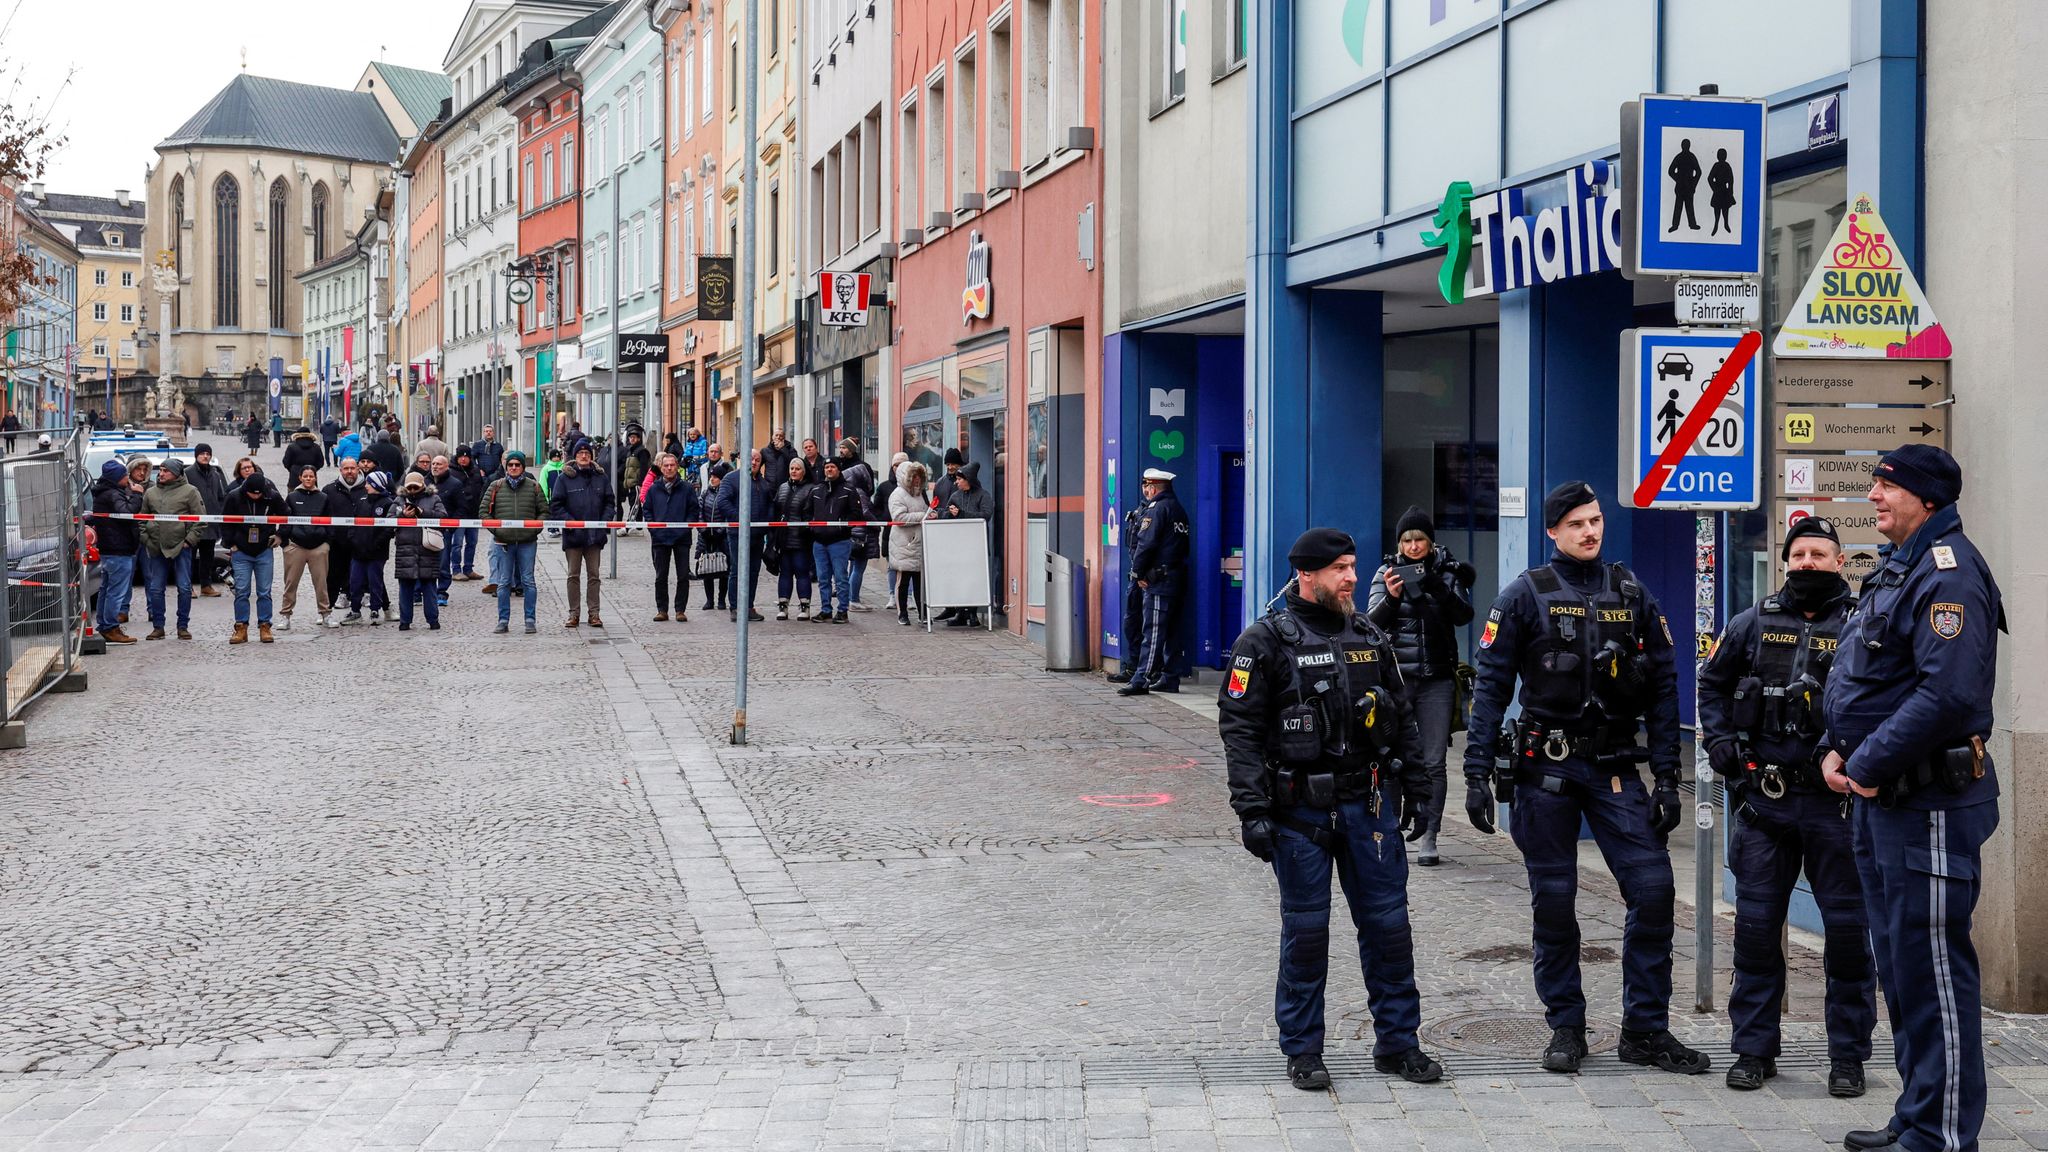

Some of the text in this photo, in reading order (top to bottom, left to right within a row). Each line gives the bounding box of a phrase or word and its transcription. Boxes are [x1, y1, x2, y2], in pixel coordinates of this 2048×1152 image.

[1816, 101, 1827, 131] 4
[1677, 281, 1758, 300] ausgenommen
[1822, 270, 1903, 298] SLOW
[829, 311, 861, 323] KFC
[1691, 302, 1745, 320] Fahrräder
[1806, 303, 1920, 326] LANGSAM
[1784, 375, 1854, 389] Lederergasse
[1705, 417, 1738, 448] 20
[1825, 422, 1896, 435] Wochenmarkt
[1818, 461, 1859, 472] KIDWAY
[1861, 461, 1876, 475] Spi
[1660, 464, 1734, 493] Zone
[1818, 481, 1836, 492] und
[1855, 560, 1878, 570] Sitzg
[1550, 606, 1586, 617] POLIZEI
[1934, 605, 1961, 613] POLIZEI
[1604, 613, 1627, 622] SIG
[1762, 632, 1798, 644] POLIZEI
[1234, 655, 1253, 669] K-07
[1297, 652, 1334, 668] POLIZEI
[1351, 653, 1372, 662] SIG
[1231, 675, 1246, 686] SIG
